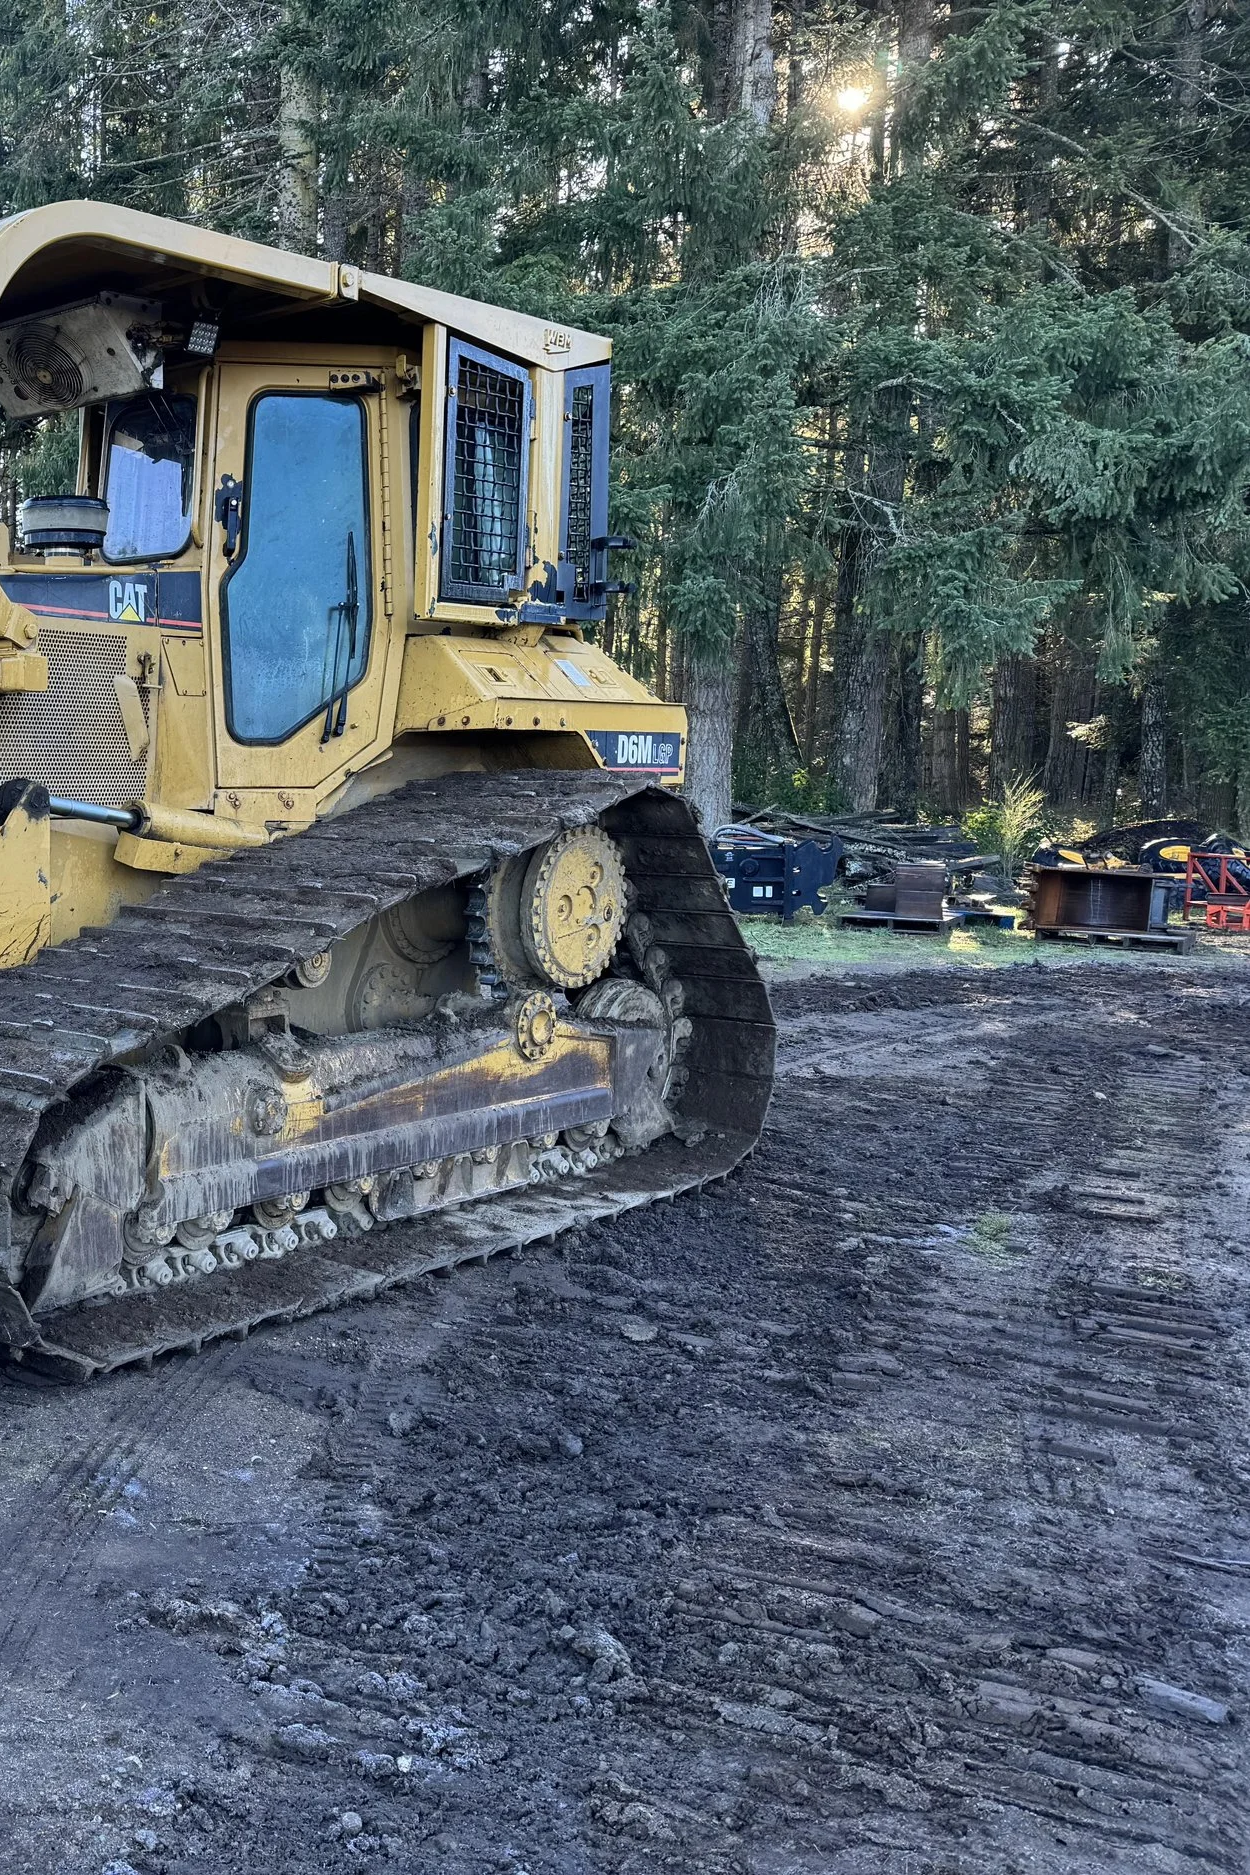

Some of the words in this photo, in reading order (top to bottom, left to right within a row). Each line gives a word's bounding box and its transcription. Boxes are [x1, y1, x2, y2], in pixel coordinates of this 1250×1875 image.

[109, 580, 148, 623] CAT
[617, 734, 652, 764] D6M
[652, 743, 674, 764] LGP
